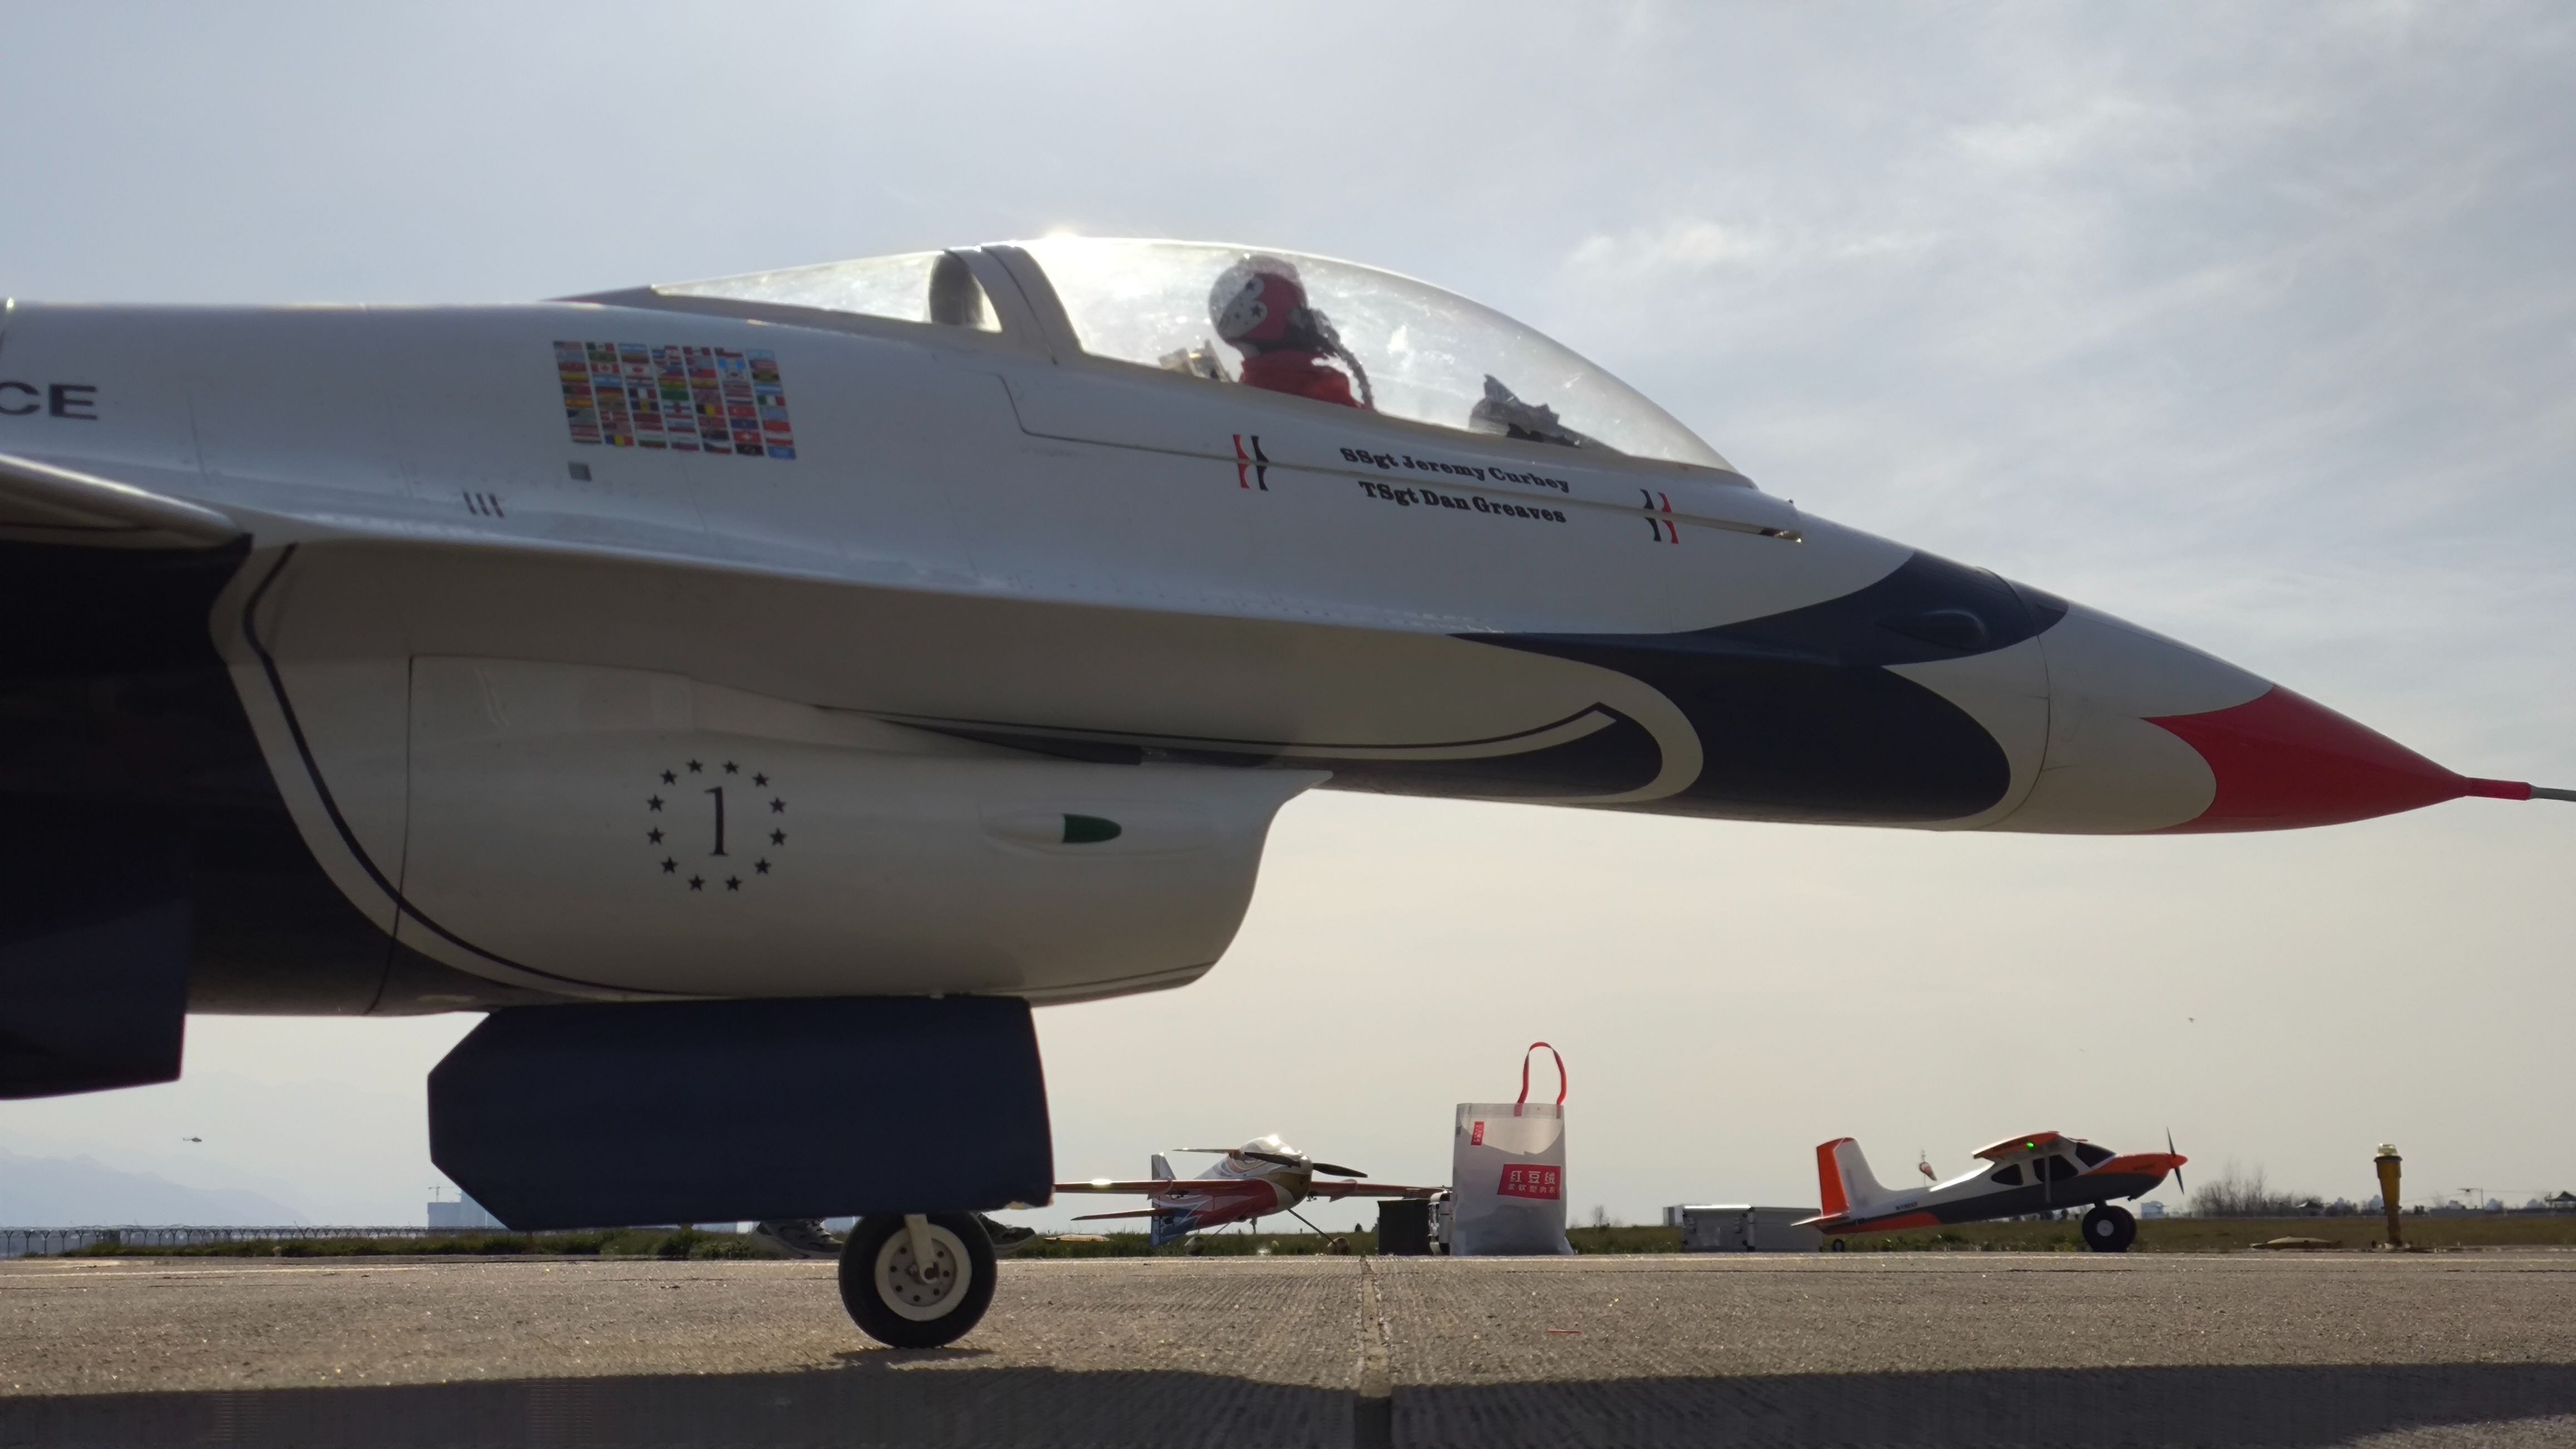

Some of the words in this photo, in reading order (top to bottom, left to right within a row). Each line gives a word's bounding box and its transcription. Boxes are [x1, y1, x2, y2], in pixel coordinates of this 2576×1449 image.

[1339, 448, 1398, 469] SSgt
[1402, 455, 1485, 481] Jeremy
[1488, 467, 1569, 493] Curbey
[1358, 481, 1419, 506] TSgt
[1420, 489, 1471, 511] Dan
[1472, 496, 1567, 523] Greaves
[703, 785, 728, 857] 1
